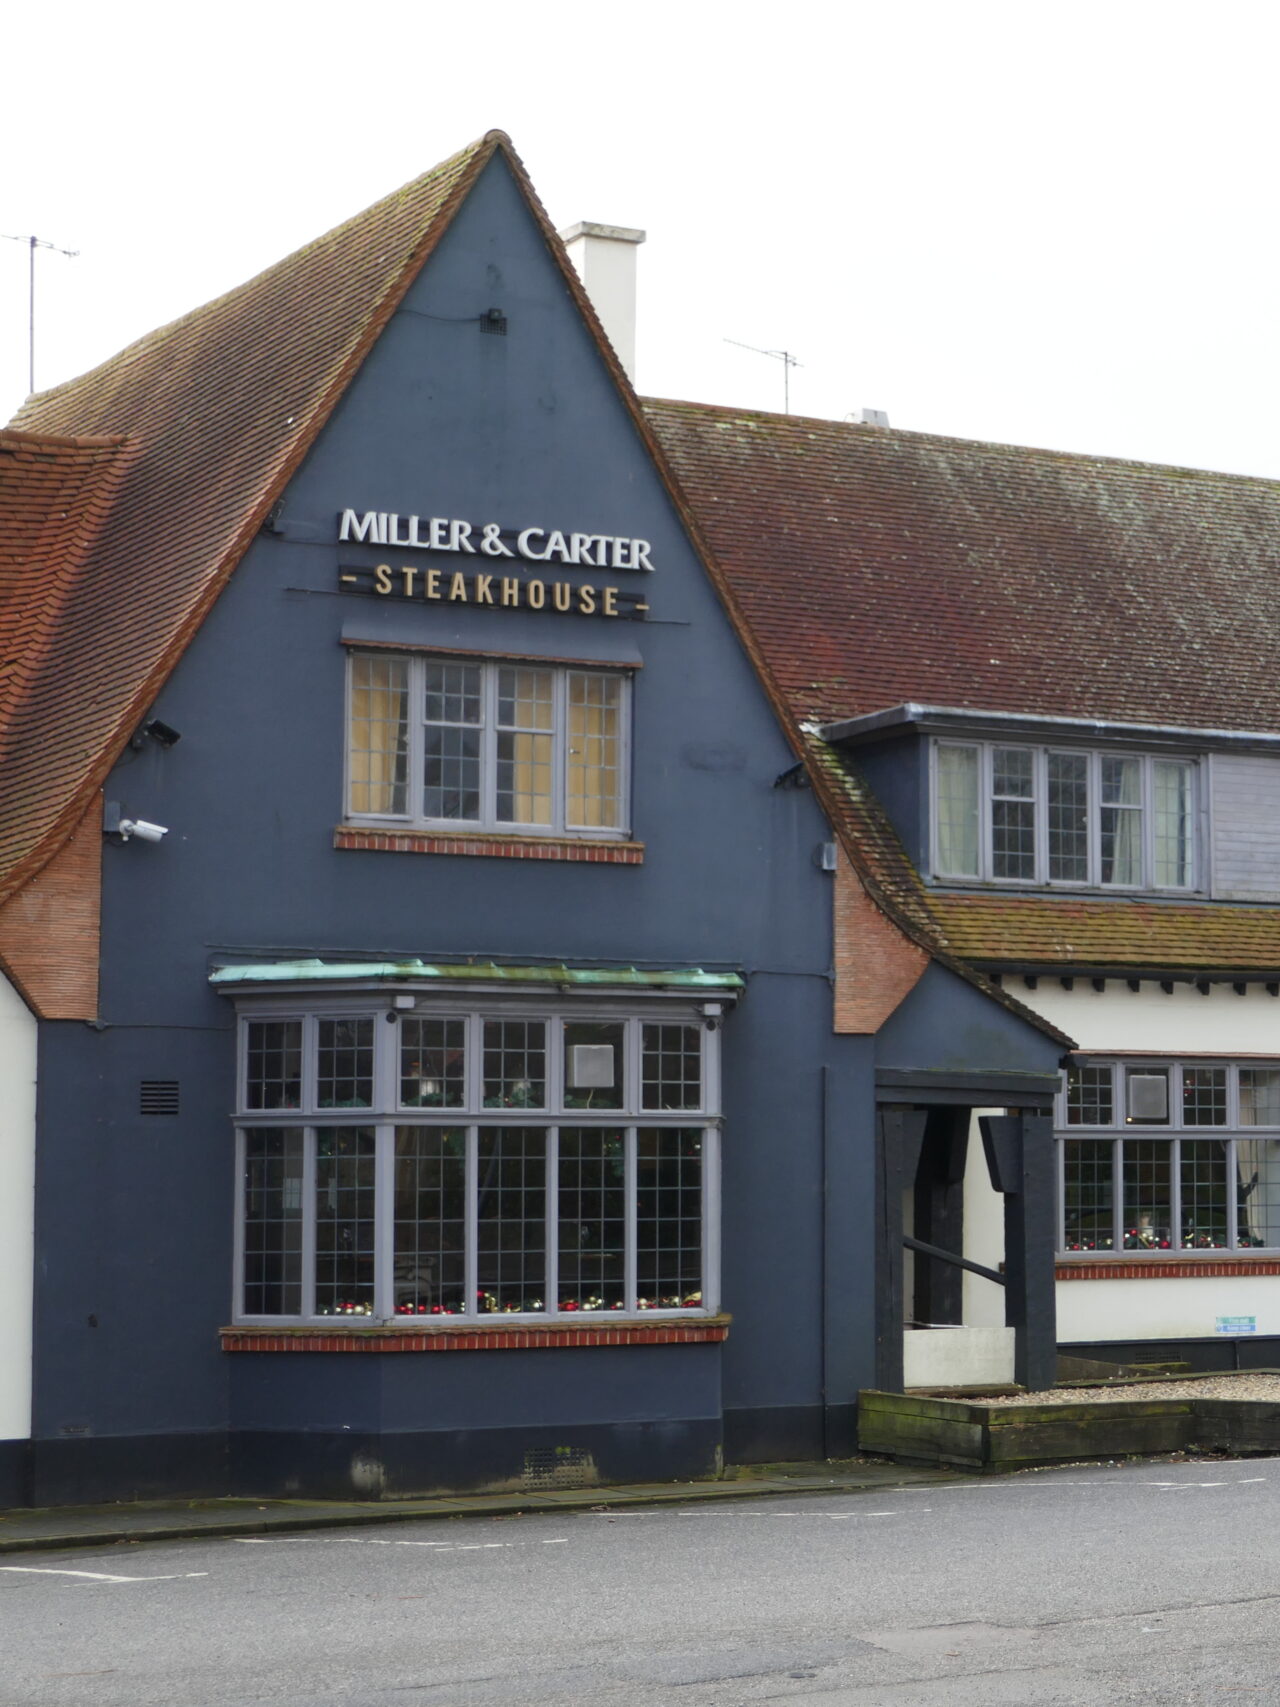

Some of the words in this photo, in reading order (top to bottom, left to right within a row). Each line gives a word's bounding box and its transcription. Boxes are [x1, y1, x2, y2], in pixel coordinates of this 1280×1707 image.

[338, 508, 477, 554] MILLER
[480, 523, 515, 557] &
[516, 526, 656, 572] CARTER
[374, 564, 619, 616] STEAKHOUSE
